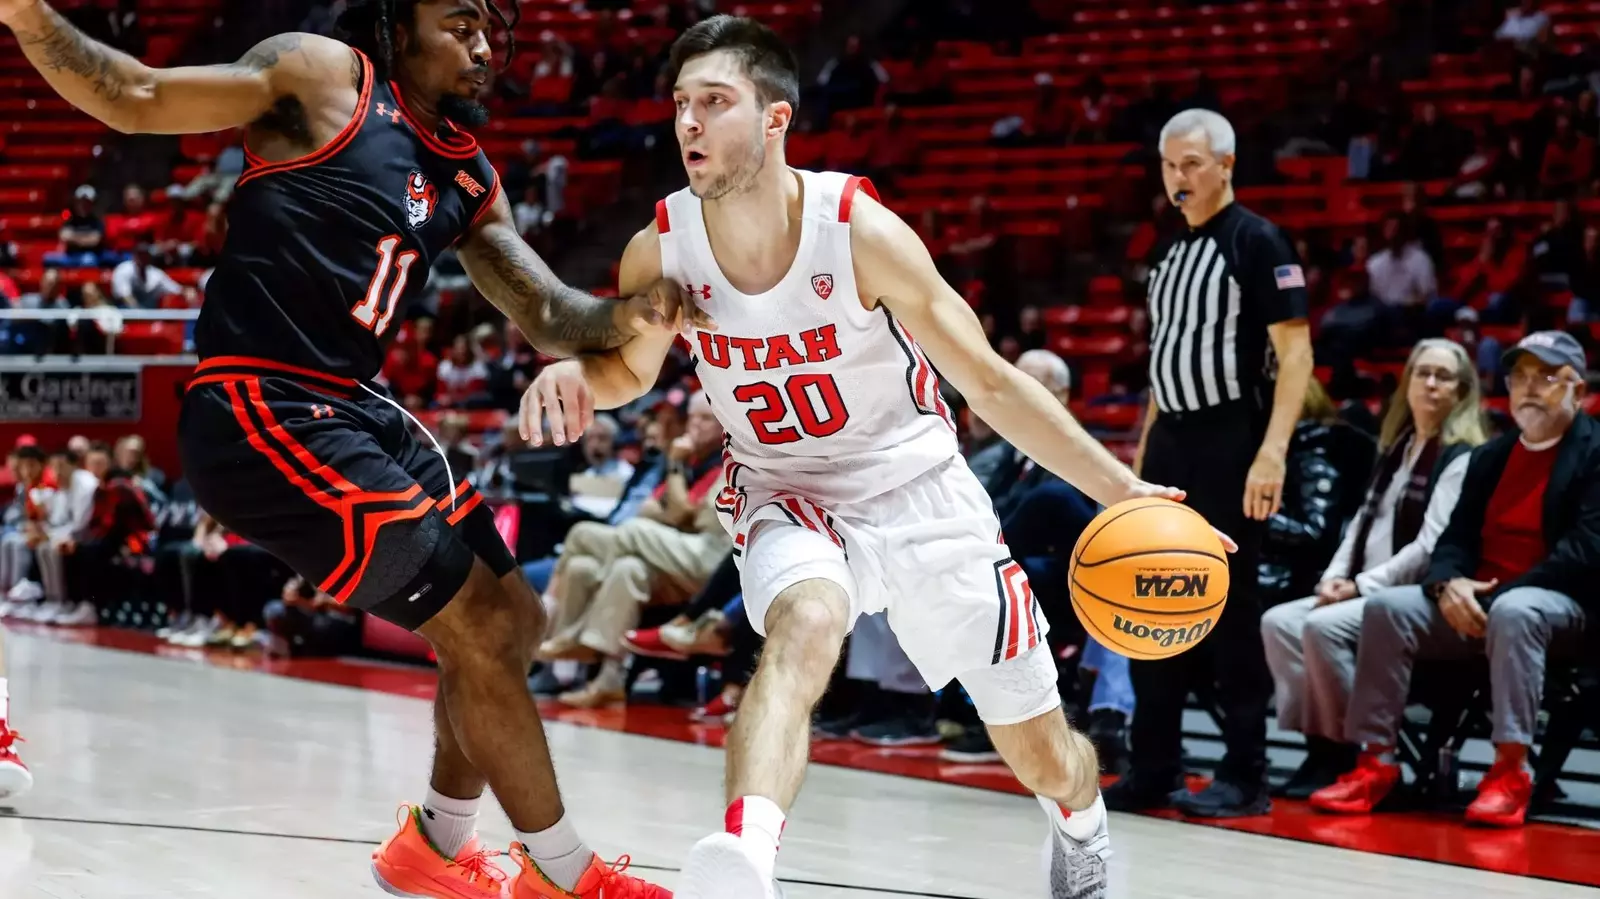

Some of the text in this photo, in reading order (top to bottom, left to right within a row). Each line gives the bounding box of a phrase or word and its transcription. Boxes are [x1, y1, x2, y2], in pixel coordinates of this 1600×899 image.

[454, 170, 486, 198] WAC
[350, 234, 419, 338] 11
[818, 284, 830, 295] 12
[697, 323, 843, 371] UTAH
[20, 371, 132, 401] Gardner
[733, 373, 850, 444] 20
[1135, 574, 1209, 597] NCAA
[1113, 614, 1212, 647] Wilson
